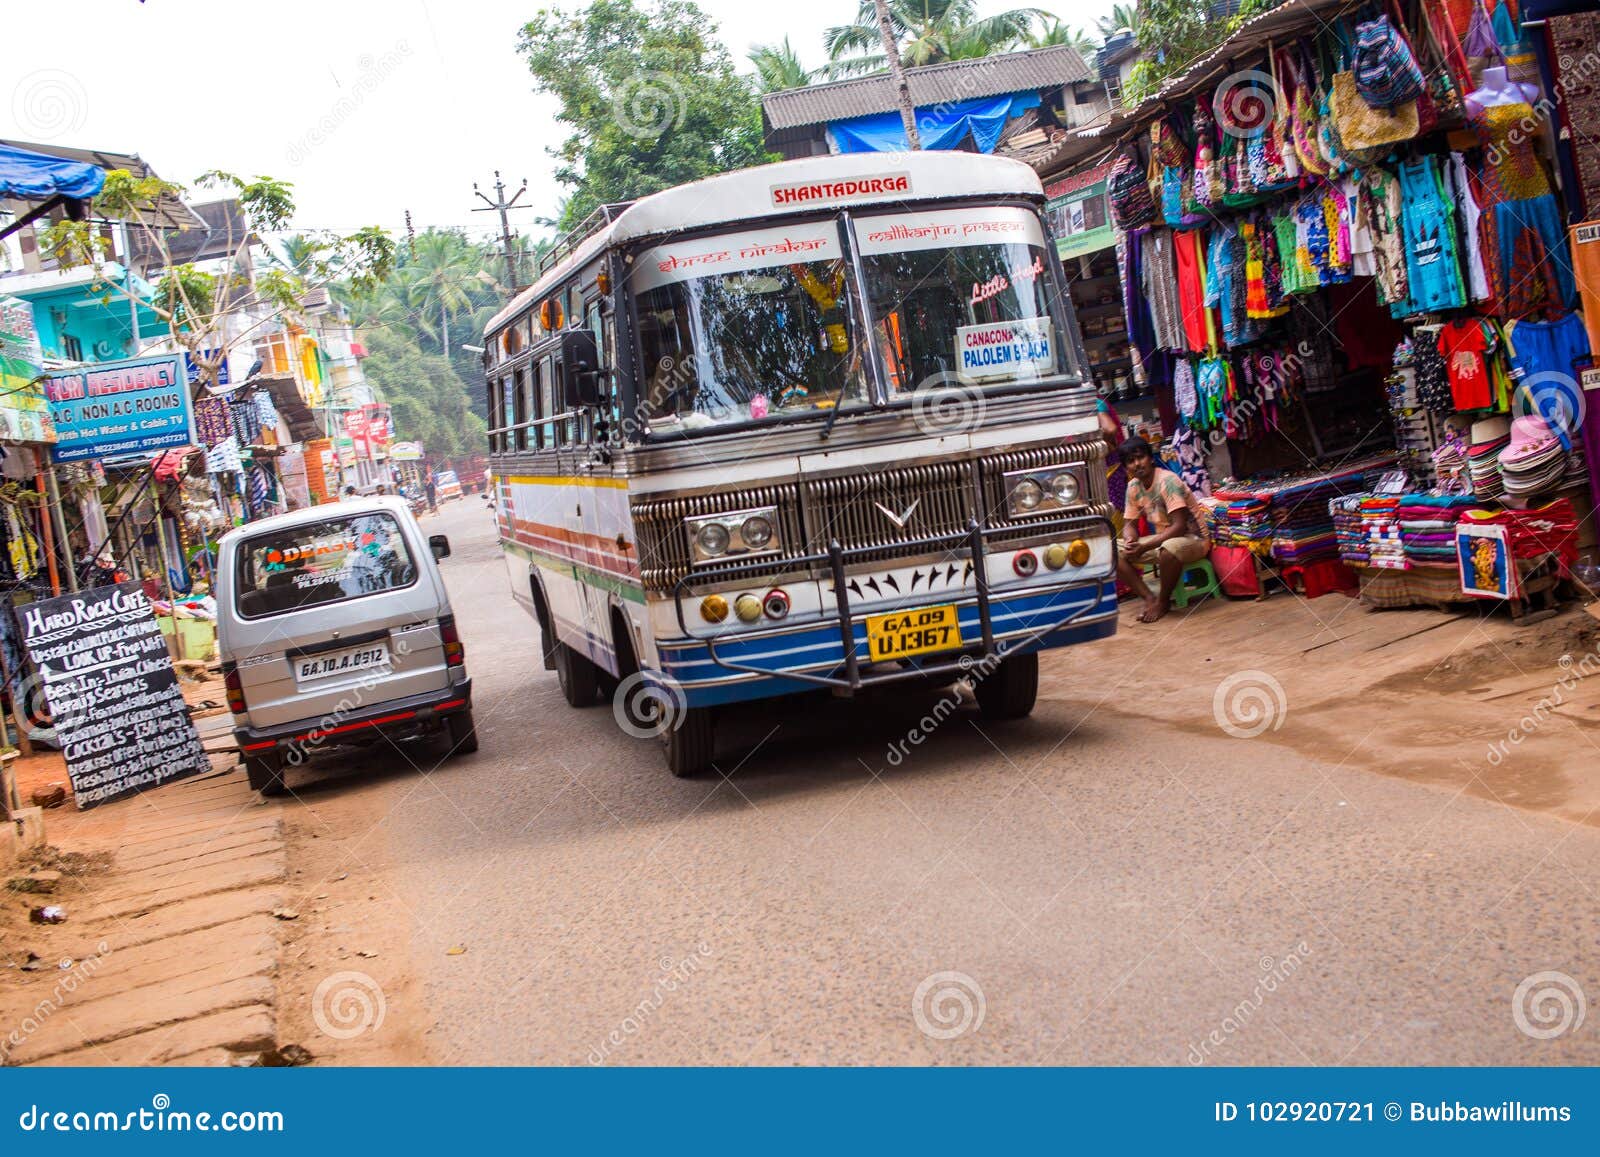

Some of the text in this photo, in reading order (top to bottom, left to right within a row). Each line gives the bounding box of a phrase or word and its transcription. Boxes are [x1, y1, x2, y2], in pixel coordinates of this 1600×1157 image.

[773, 176, 909, 204] SHANTADURGA
[657, 238, 827, 273] shree nirakar
[969, 274, 1008, 305] Little
[963, 345, 1012, 368] PALOLEM
[82, 403, 109, 420] NON
[136, 393, 180, 413] ROOMS
[80, 426, 98, 438] Hot
[100, 422, 128, 435] Water
[131, 420, 138, 431] &
[141, 416, 168, 429] Cable
[170, 415, 184, 426] TV
[884, 610, 945, 633] GA.09
[878, 626, 950, 655] U.1367
